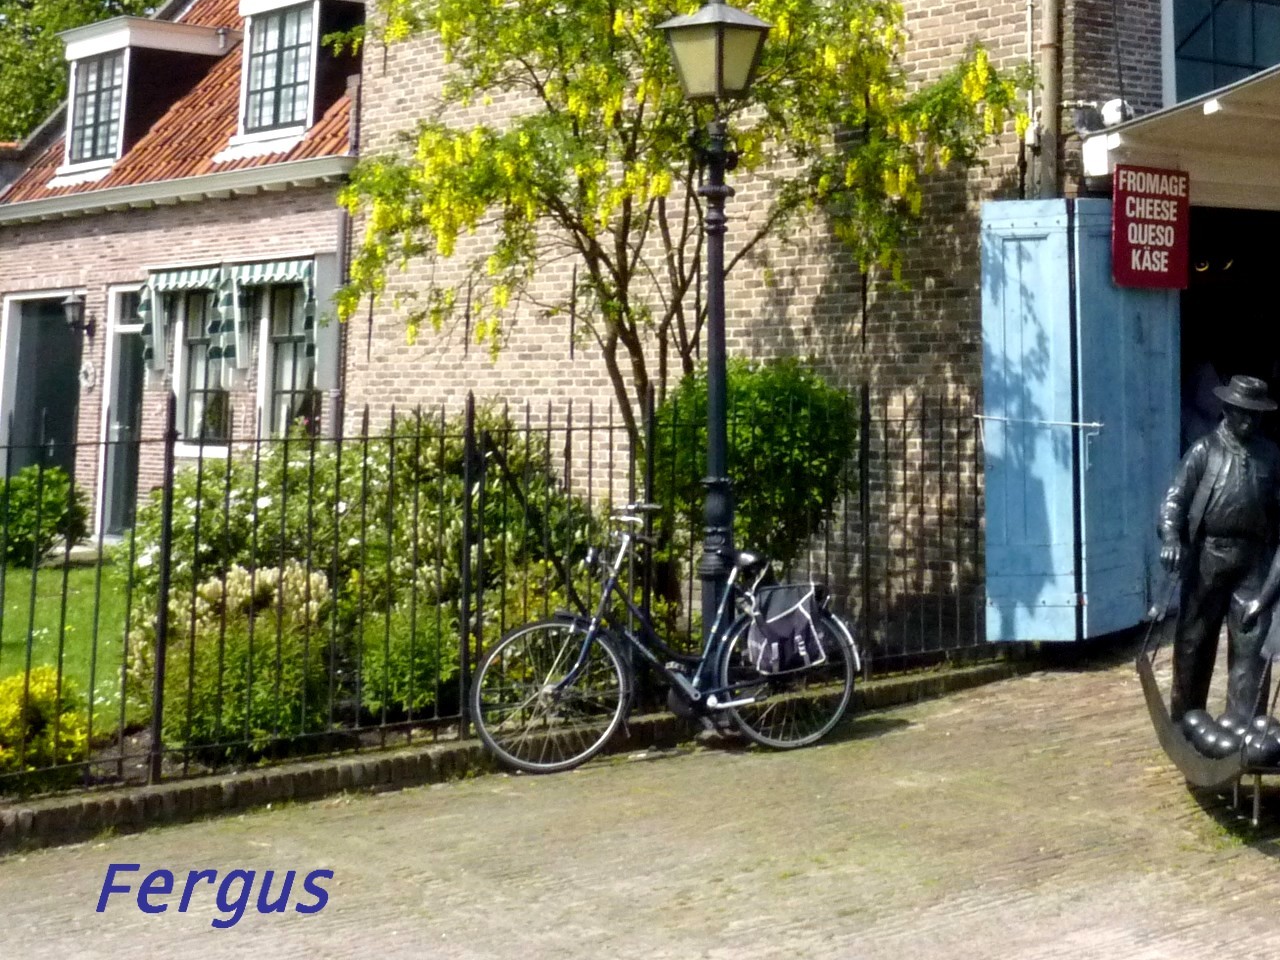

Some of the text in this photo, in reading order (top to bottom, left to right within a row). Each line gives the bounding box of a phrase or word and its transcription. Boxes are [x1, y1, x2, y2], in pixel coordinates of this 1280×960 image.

[1118, 170, 1187, 197] FROMAGE
[1125, 196, 1178, 221] CHEESE
[1127, 222, 1175, 247] QUESO
[1131, 246, 1169, 272] KÄSE
